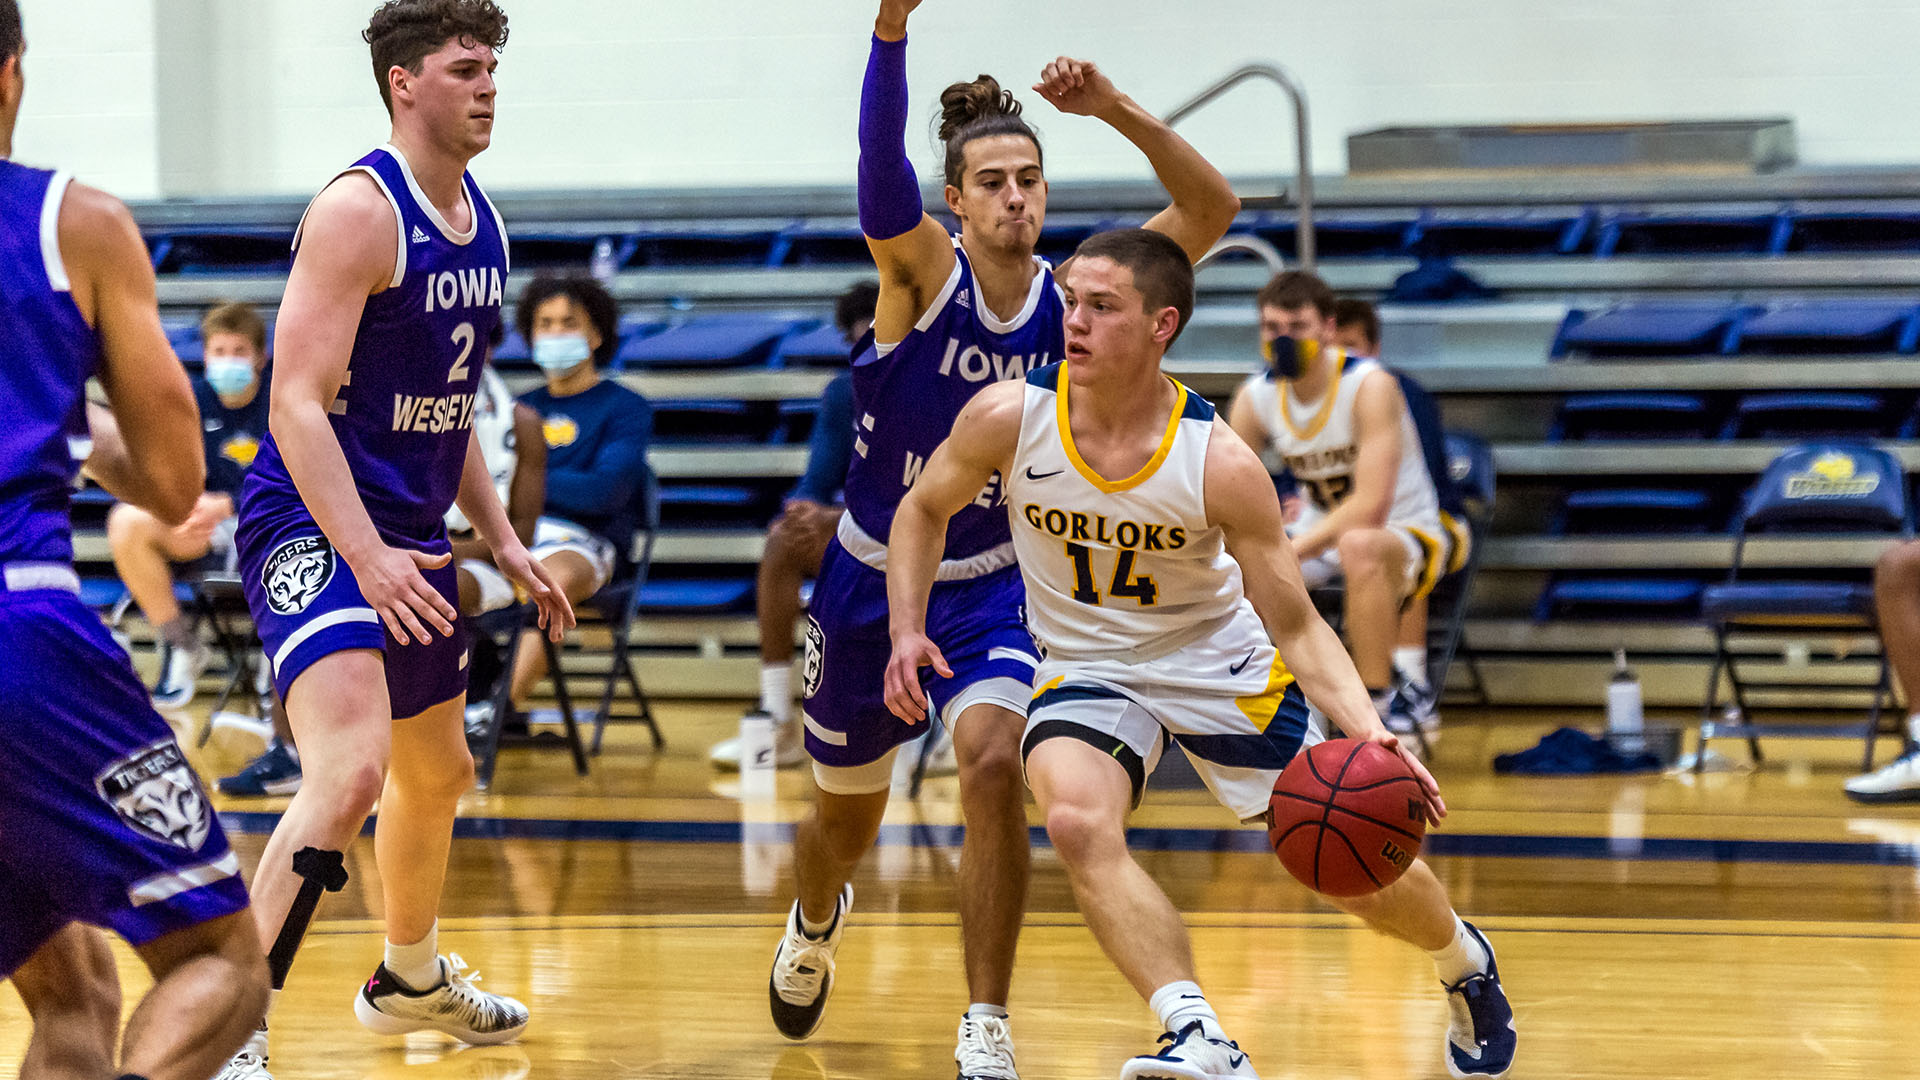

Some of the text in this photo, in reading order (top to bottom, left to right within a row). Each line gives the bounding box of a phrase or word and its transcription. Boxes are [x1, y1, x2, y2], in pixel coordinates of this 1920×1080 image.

[426, 267, 502, 313] IOWA
[447, 322, 475, 384] 2
[938, 337, 1049, 382] IOW
[392, 393, 476, 434] WESEY
[1024, 503, 1186, 551] GORLOKS
[268, 537, 319, 573] TIGERS
[1064, 540, 1159, 606] 14
